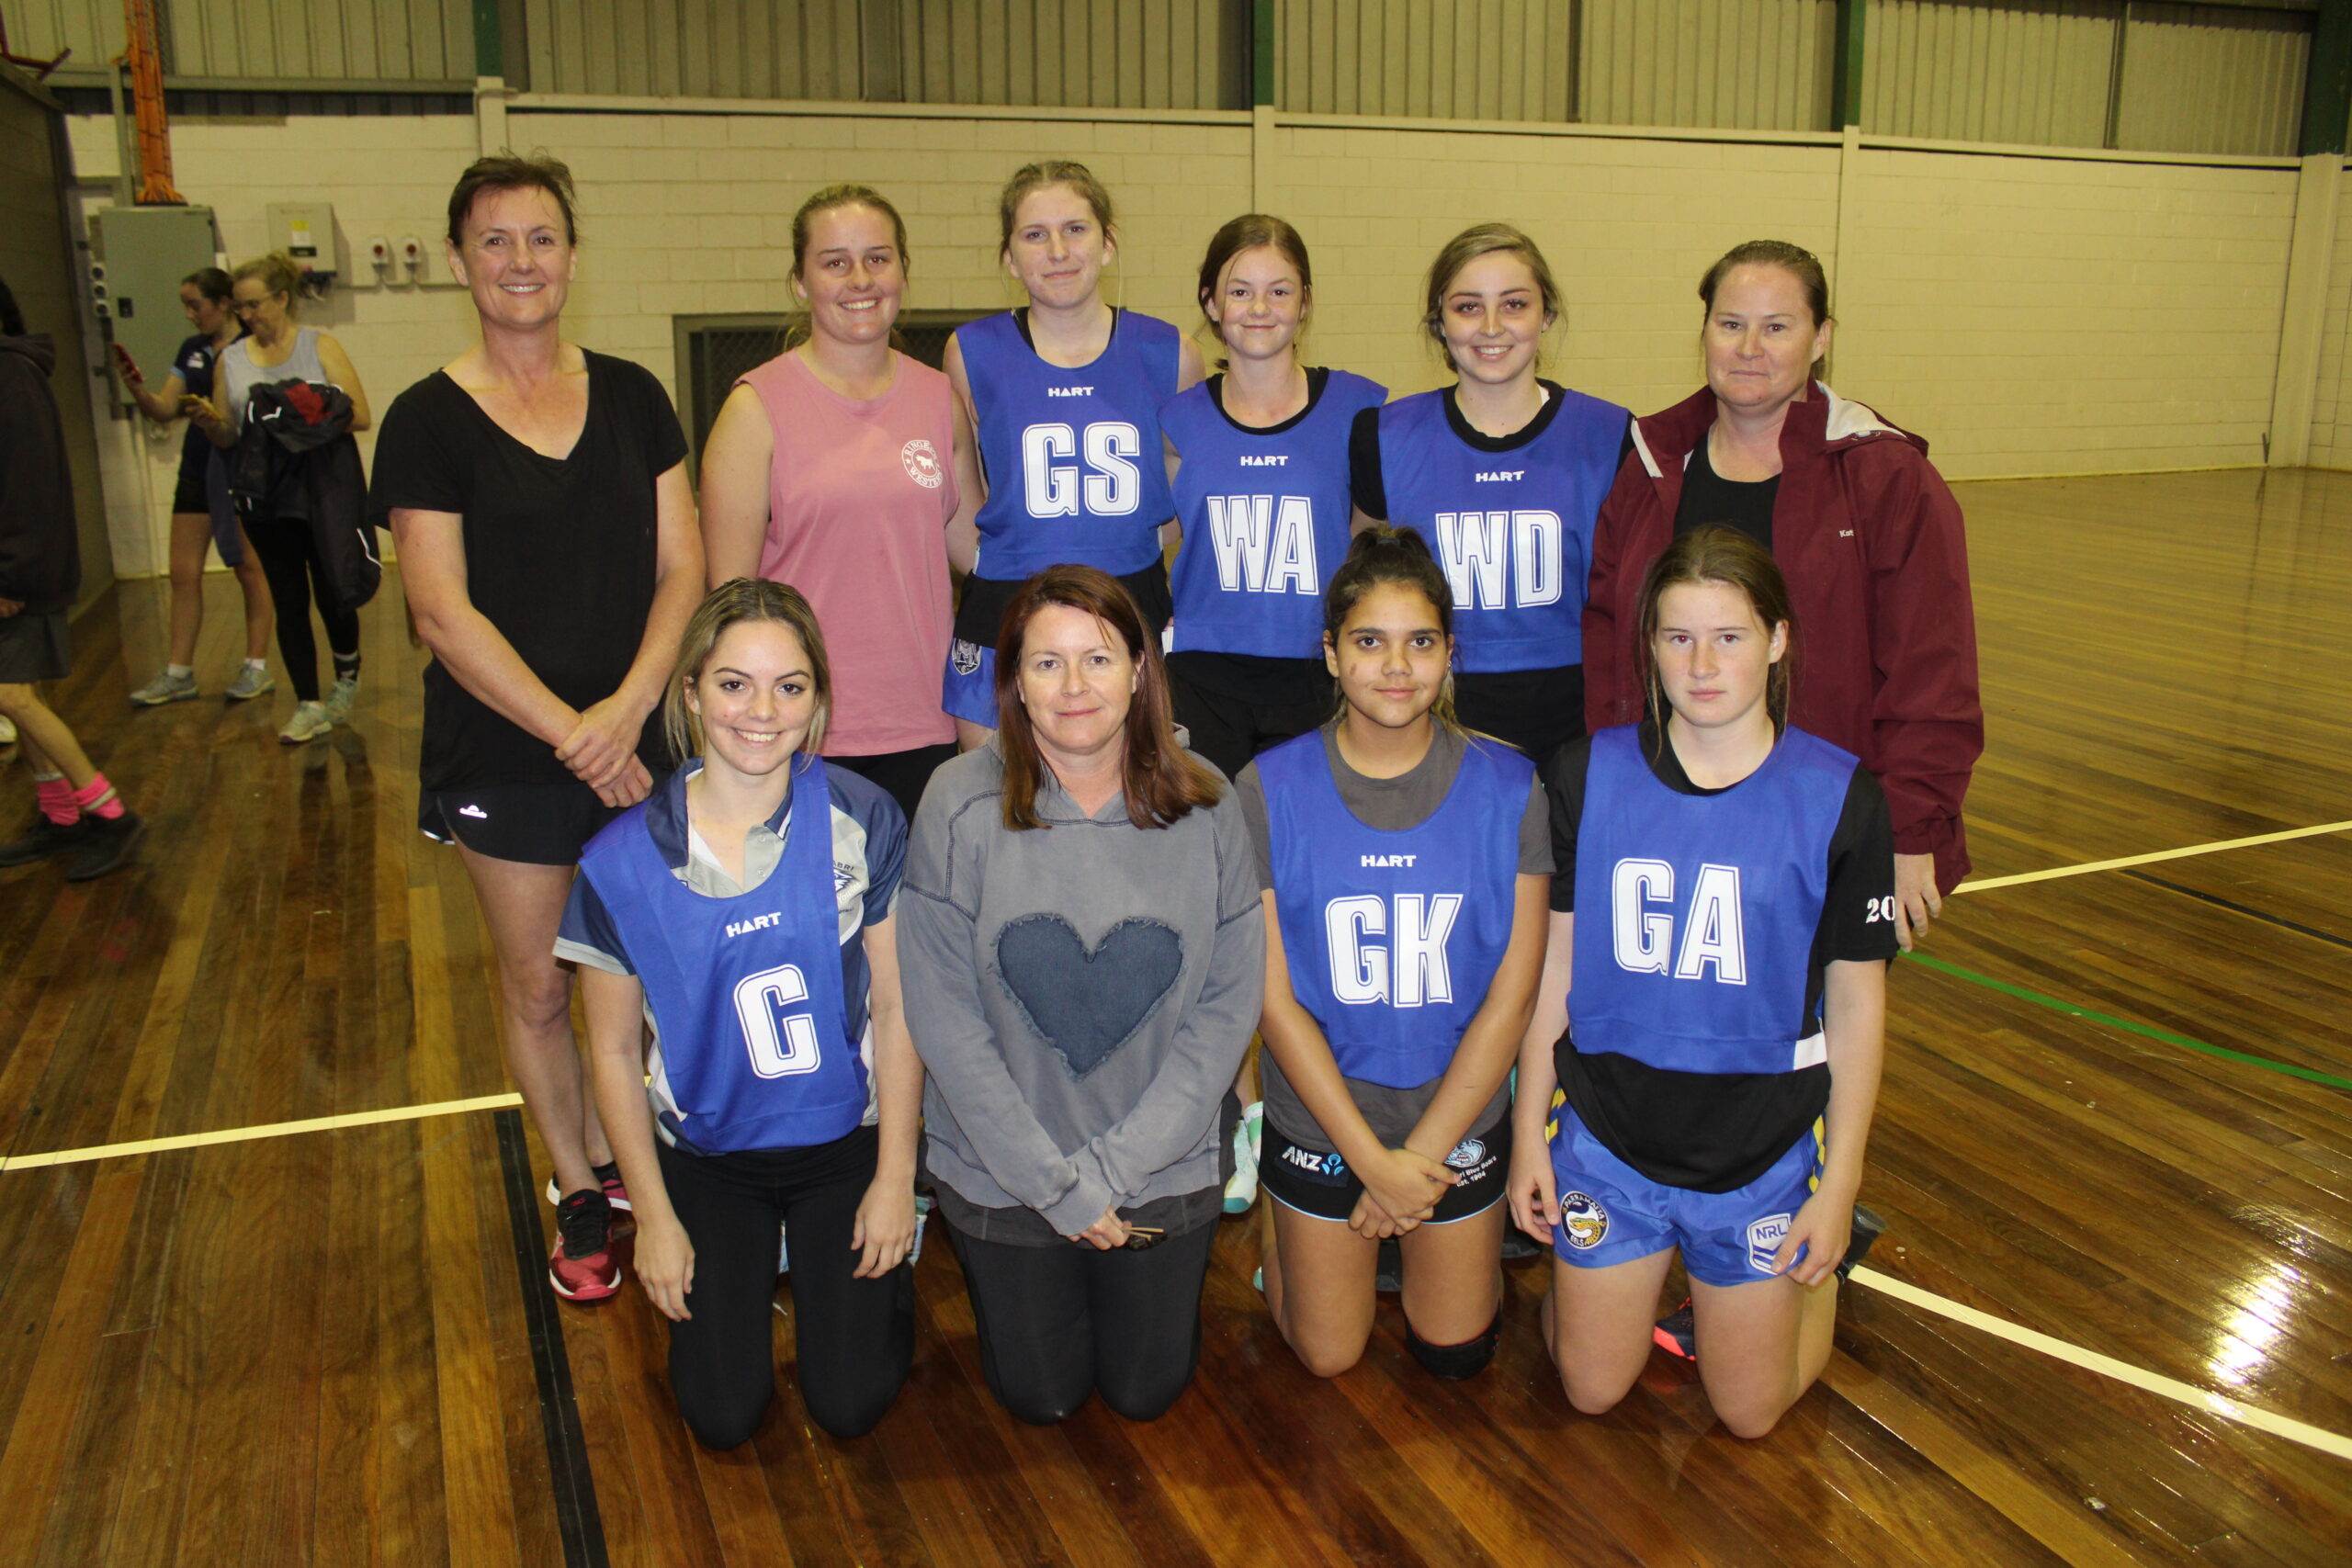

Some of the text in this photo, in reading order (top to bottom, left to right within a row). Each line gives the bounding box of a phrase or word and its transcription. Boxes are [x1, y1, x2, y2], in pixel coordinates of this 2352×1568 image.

[1047, 386, 1094, 398] HART
[1022, 422, 1140, 519] GS
[1239, 455, 1289, 467] HART
[1475, 470, 1525, 483] HART
[1206, 494, 1319, 596] WA
[1435, 510, 1563, 611] WD
[1361, 854, 1418, 868] HART
[725, 911, 782, 939] HART
[1611, 856, 1747, 986] GA
[1325, 893, 1464, 1009] GK
[733, 964, 822, 1079] C
[1282, 1145, 1323, 1172] ANZ
[1569, 1235, 1585, 1247] EELS
[1756, 1224, 1788, 1240] NRL
